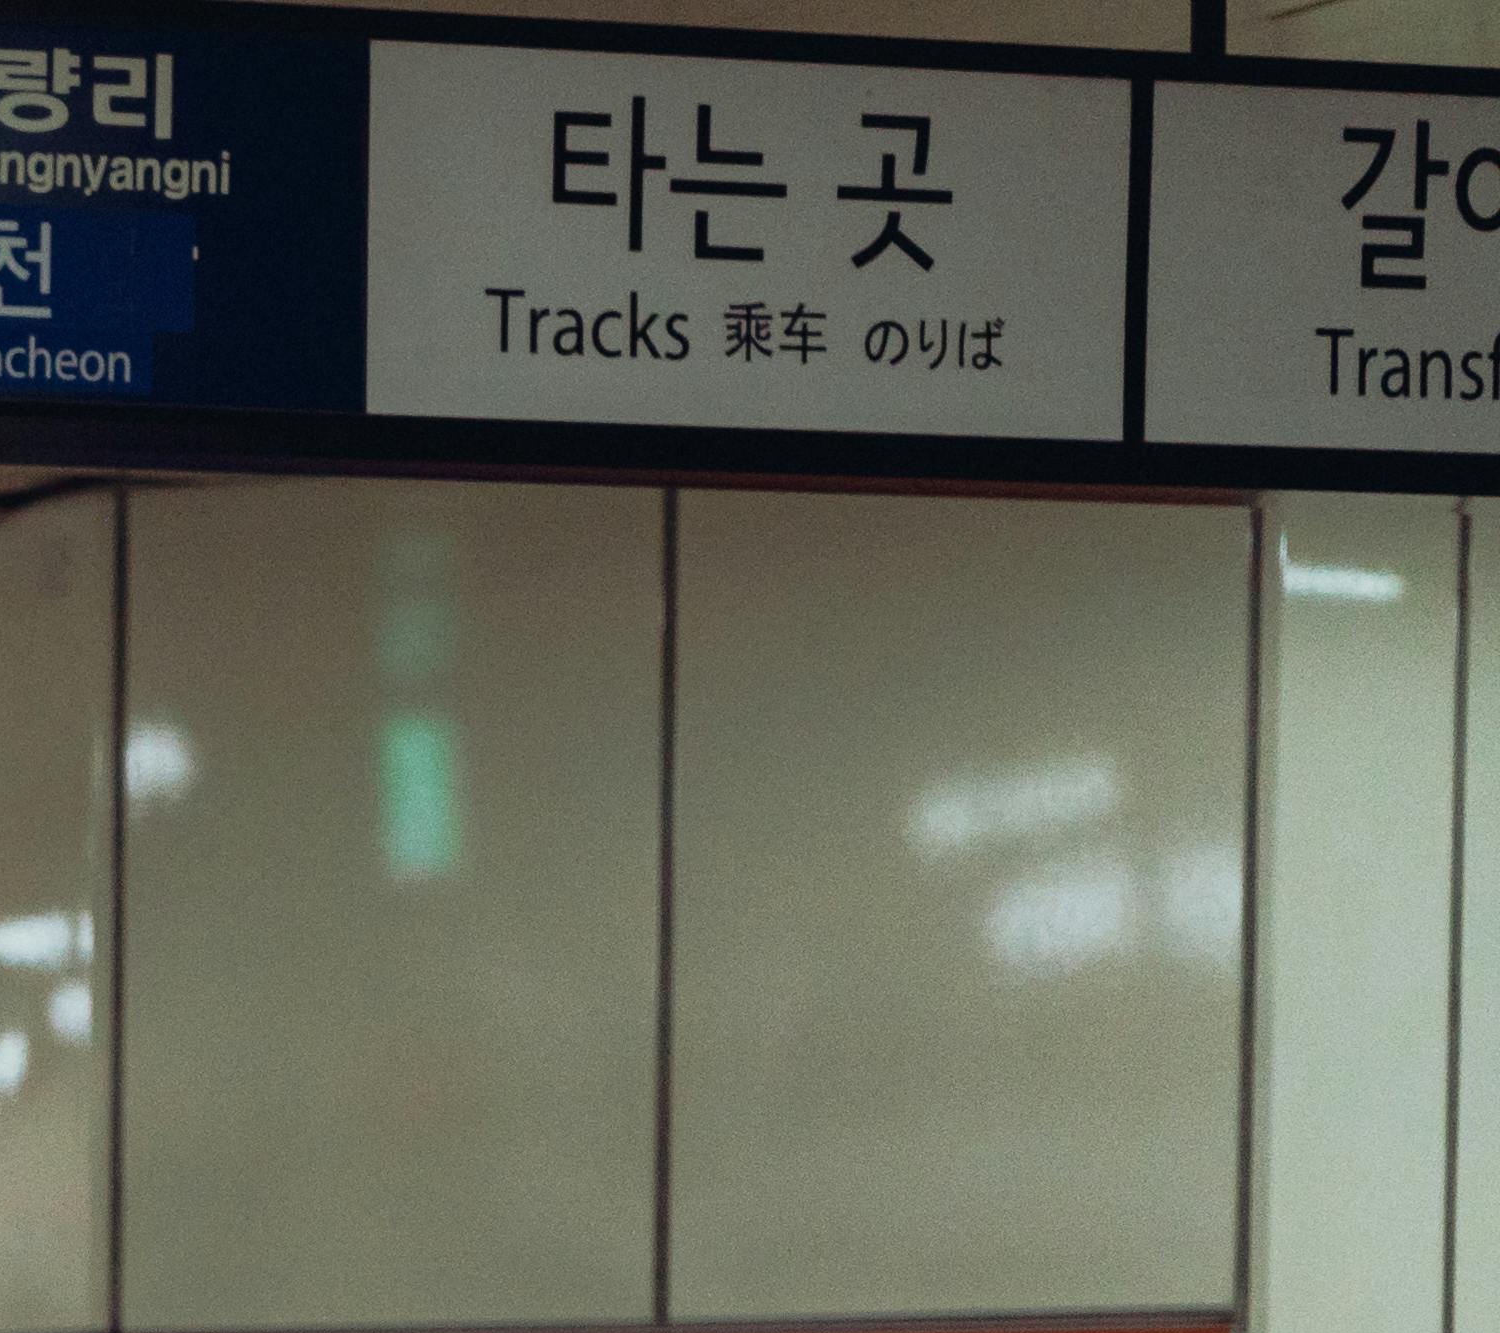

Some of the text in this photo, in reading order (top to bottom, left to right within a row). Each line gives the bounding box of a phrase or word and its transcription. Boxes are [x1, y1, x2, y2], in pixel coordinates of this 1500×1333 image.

[552, 94, 954, 272] 타는 곳
[484, 287, 1006, 371] Tracks 乘车 のりば
